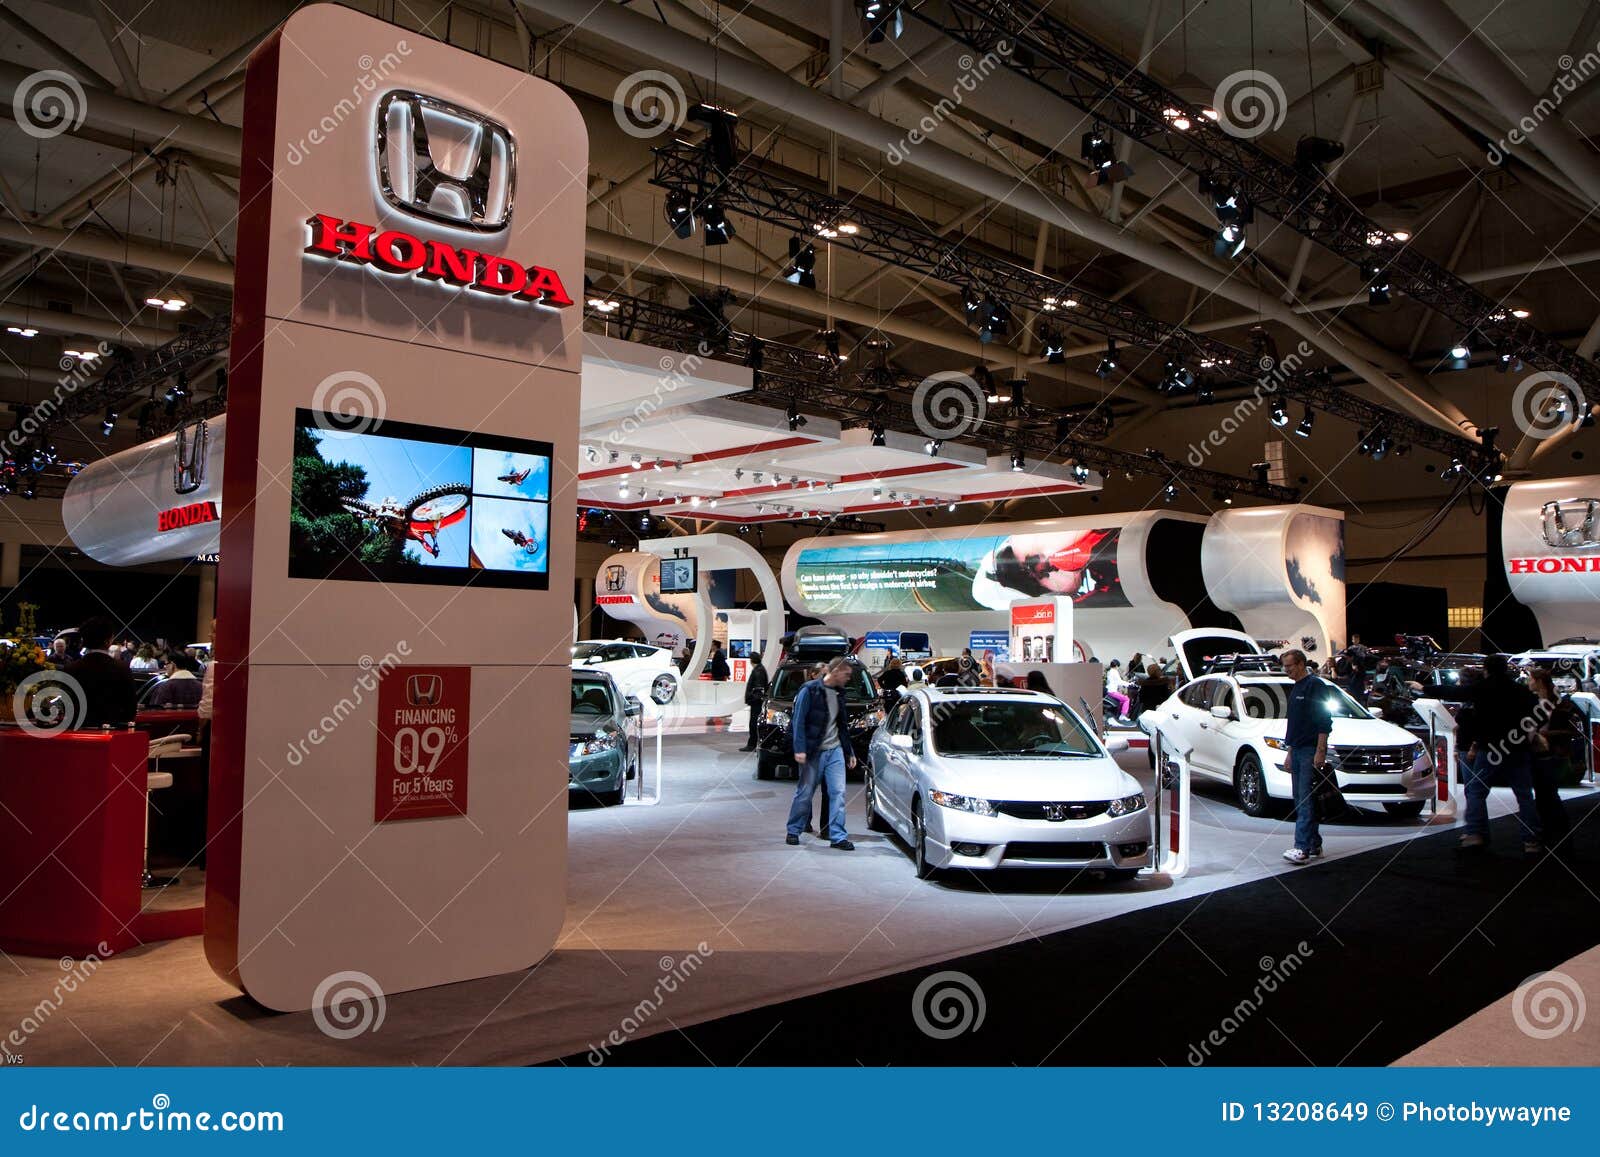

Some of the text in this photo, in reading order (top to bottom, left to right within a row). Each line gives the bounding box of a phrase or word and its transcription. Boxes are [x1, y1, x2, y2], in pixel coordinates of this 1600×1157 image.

[303, 213, 574, 309] HONDA
[158, 500, 219, 532] HONDA
[394, 709, 456, 725] FINANCING
[393, 776, 454, 795] For 5 Years
